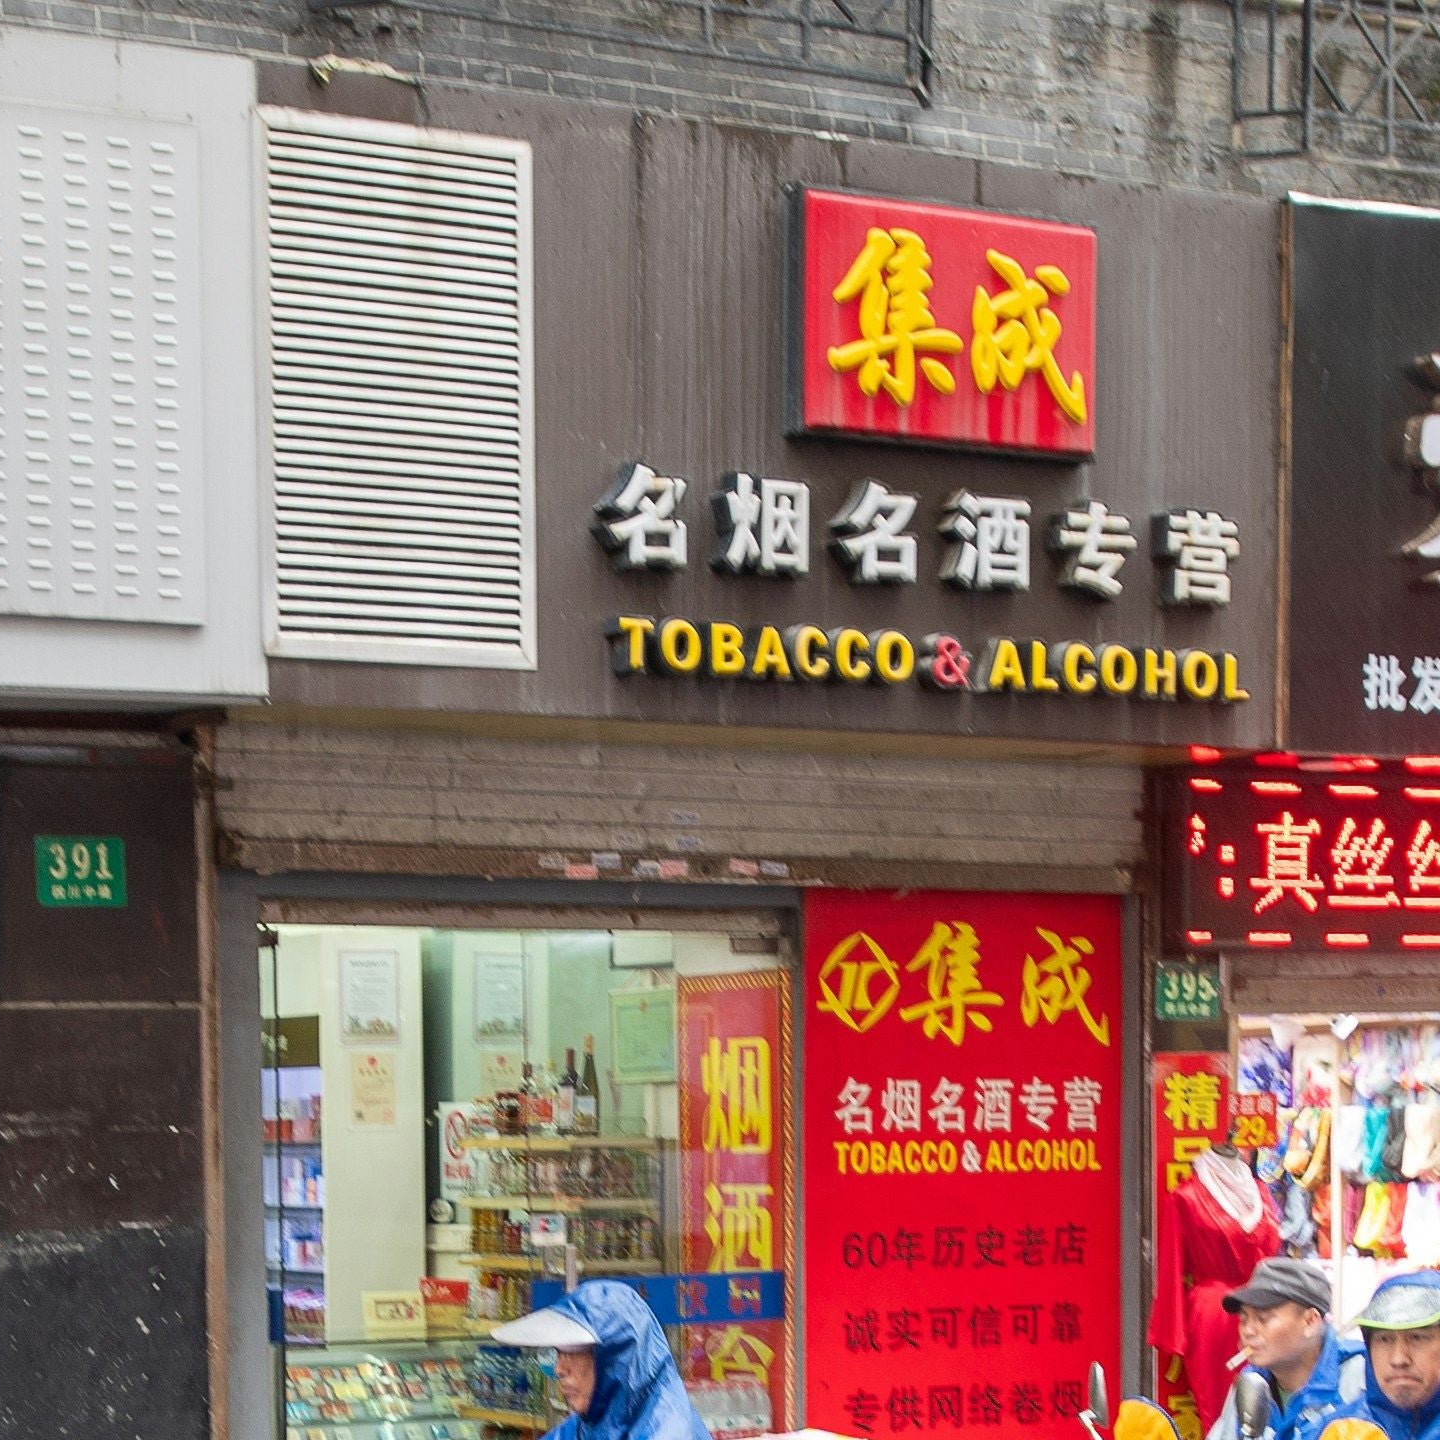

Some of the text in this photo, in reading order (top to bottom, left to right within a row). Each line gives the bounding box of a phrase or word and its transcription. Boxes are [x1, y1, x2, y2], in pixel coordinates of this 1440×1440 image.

[826, 227, 1088, 426] 集成
[602, 462, 1240, 606] 名烟名酒专营
[617, 616, 1251, 703] TOBACCO & ALCOHOL
[48, 842, 114, 881] 391
[900, 919, 1112, 1048] 集成
[1165, 968, 1218, 1001] 395
[833, 1076, 1103, 1136] 名烟名酒专营
[833, 1138, 1102, 1176] TOBACCO & ALCOHOL
[841, 1222, 1089, 1271] 60年历史老店
[842, 1302, 1086, 1355] 诚实可信可靠
